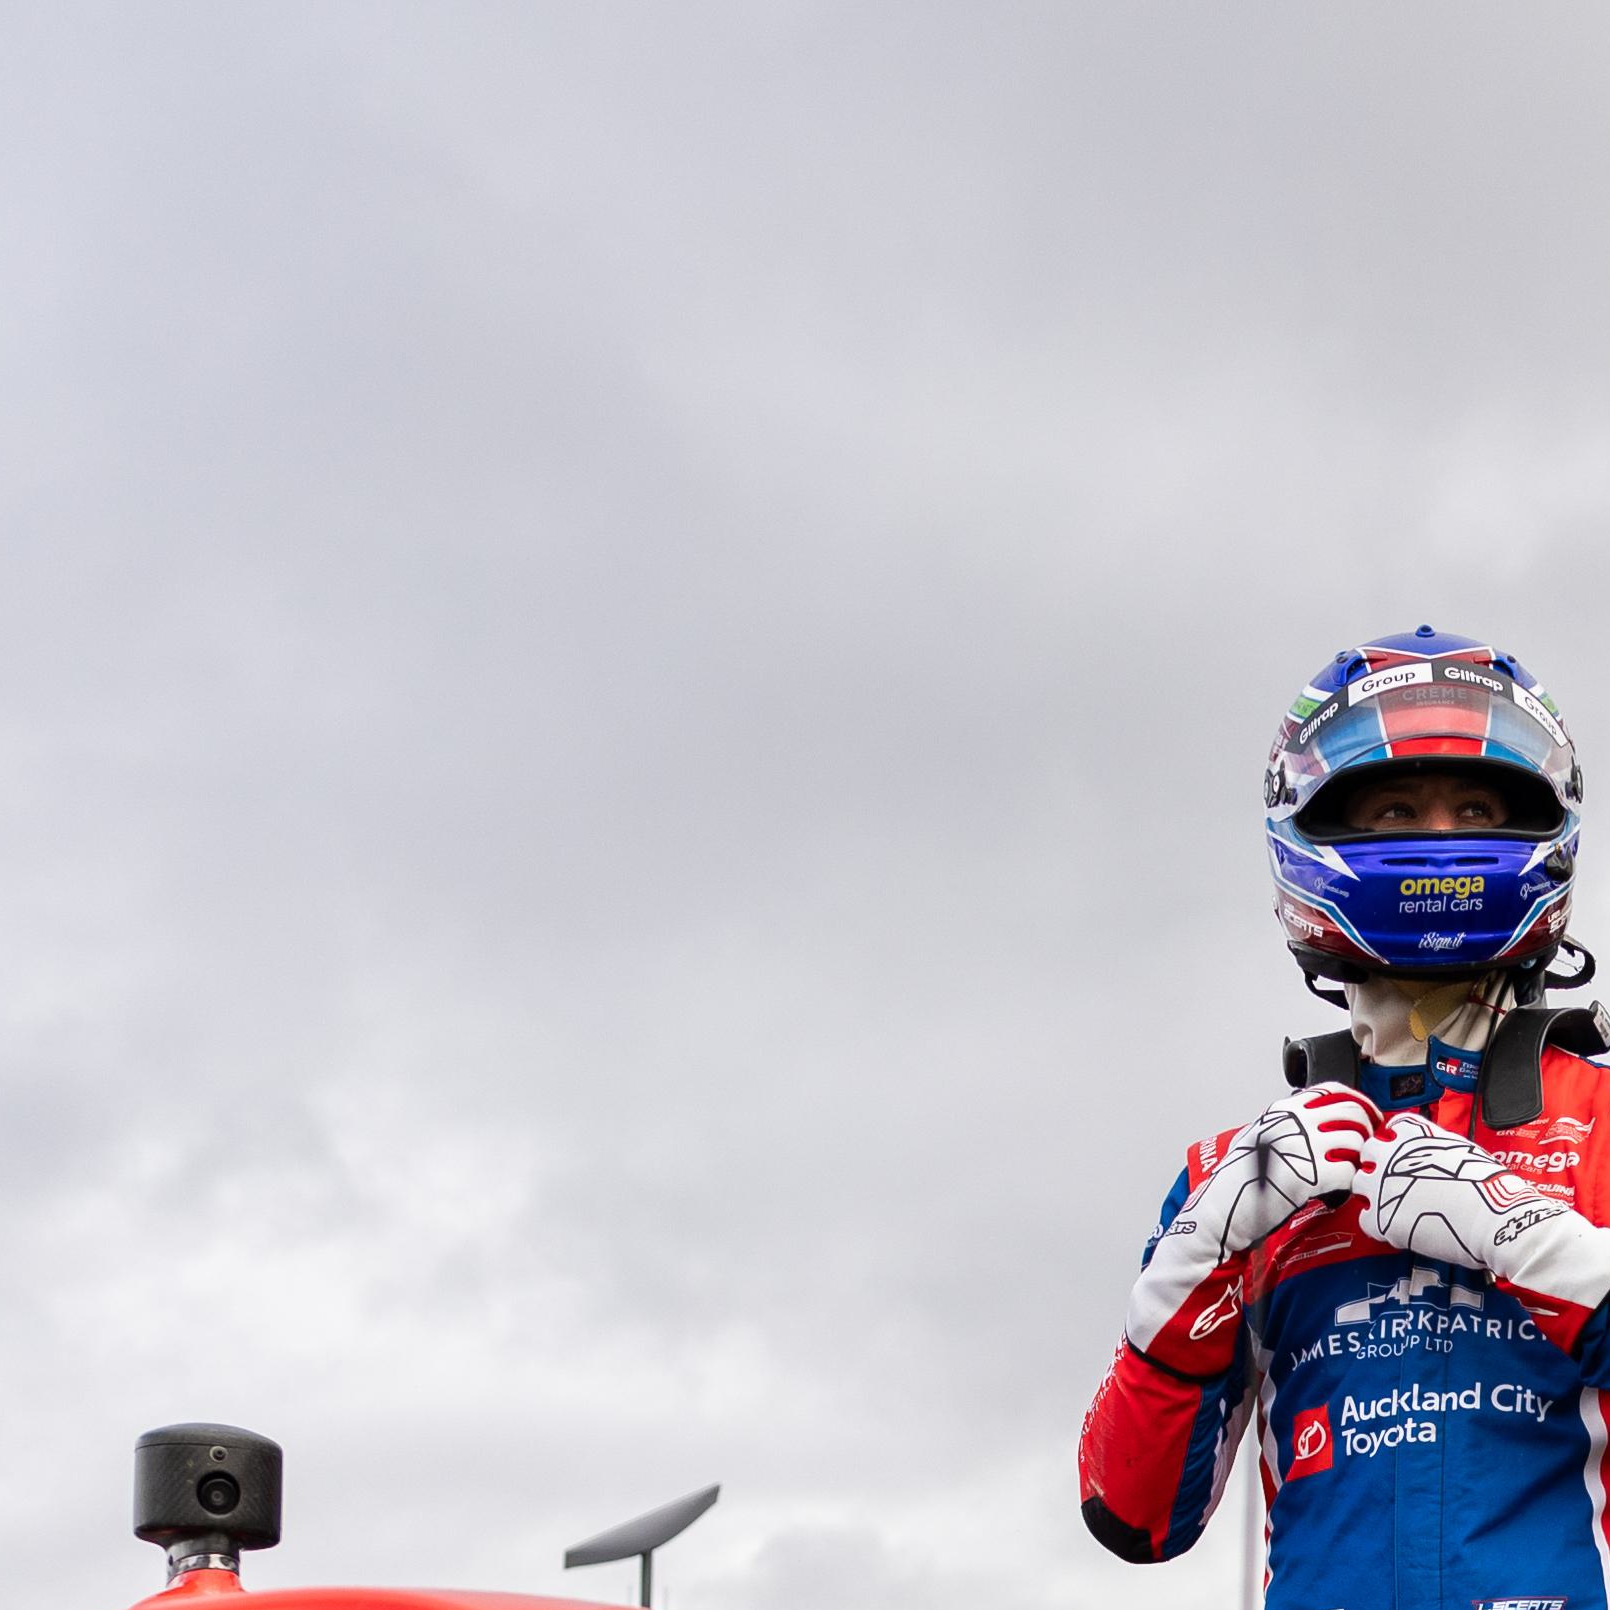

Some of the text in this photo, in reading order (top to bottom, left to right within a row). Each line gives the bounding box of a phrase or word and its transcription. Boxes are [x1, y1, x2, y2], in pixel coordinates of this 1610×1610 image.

[1362, 672, 1415, 692] Group
[1444, 667, 1558, 735] Giltrap Group
[1400, 875, 1485, 898] omega
[1399, 896, 1483, 913] rental cars
[1436, 1061, 1458, 1076] GR
[1490, 1150, 1580, 1173] omega
[1291, 1309, 1548, 1371] JAMES IRKPATRIC
[1355, 1334, 1454, 1360] GROUP LTD
[1340, 1382, 1554, 1426] Auckland City
[1341, 1417, 1437, 1457] Toyota
